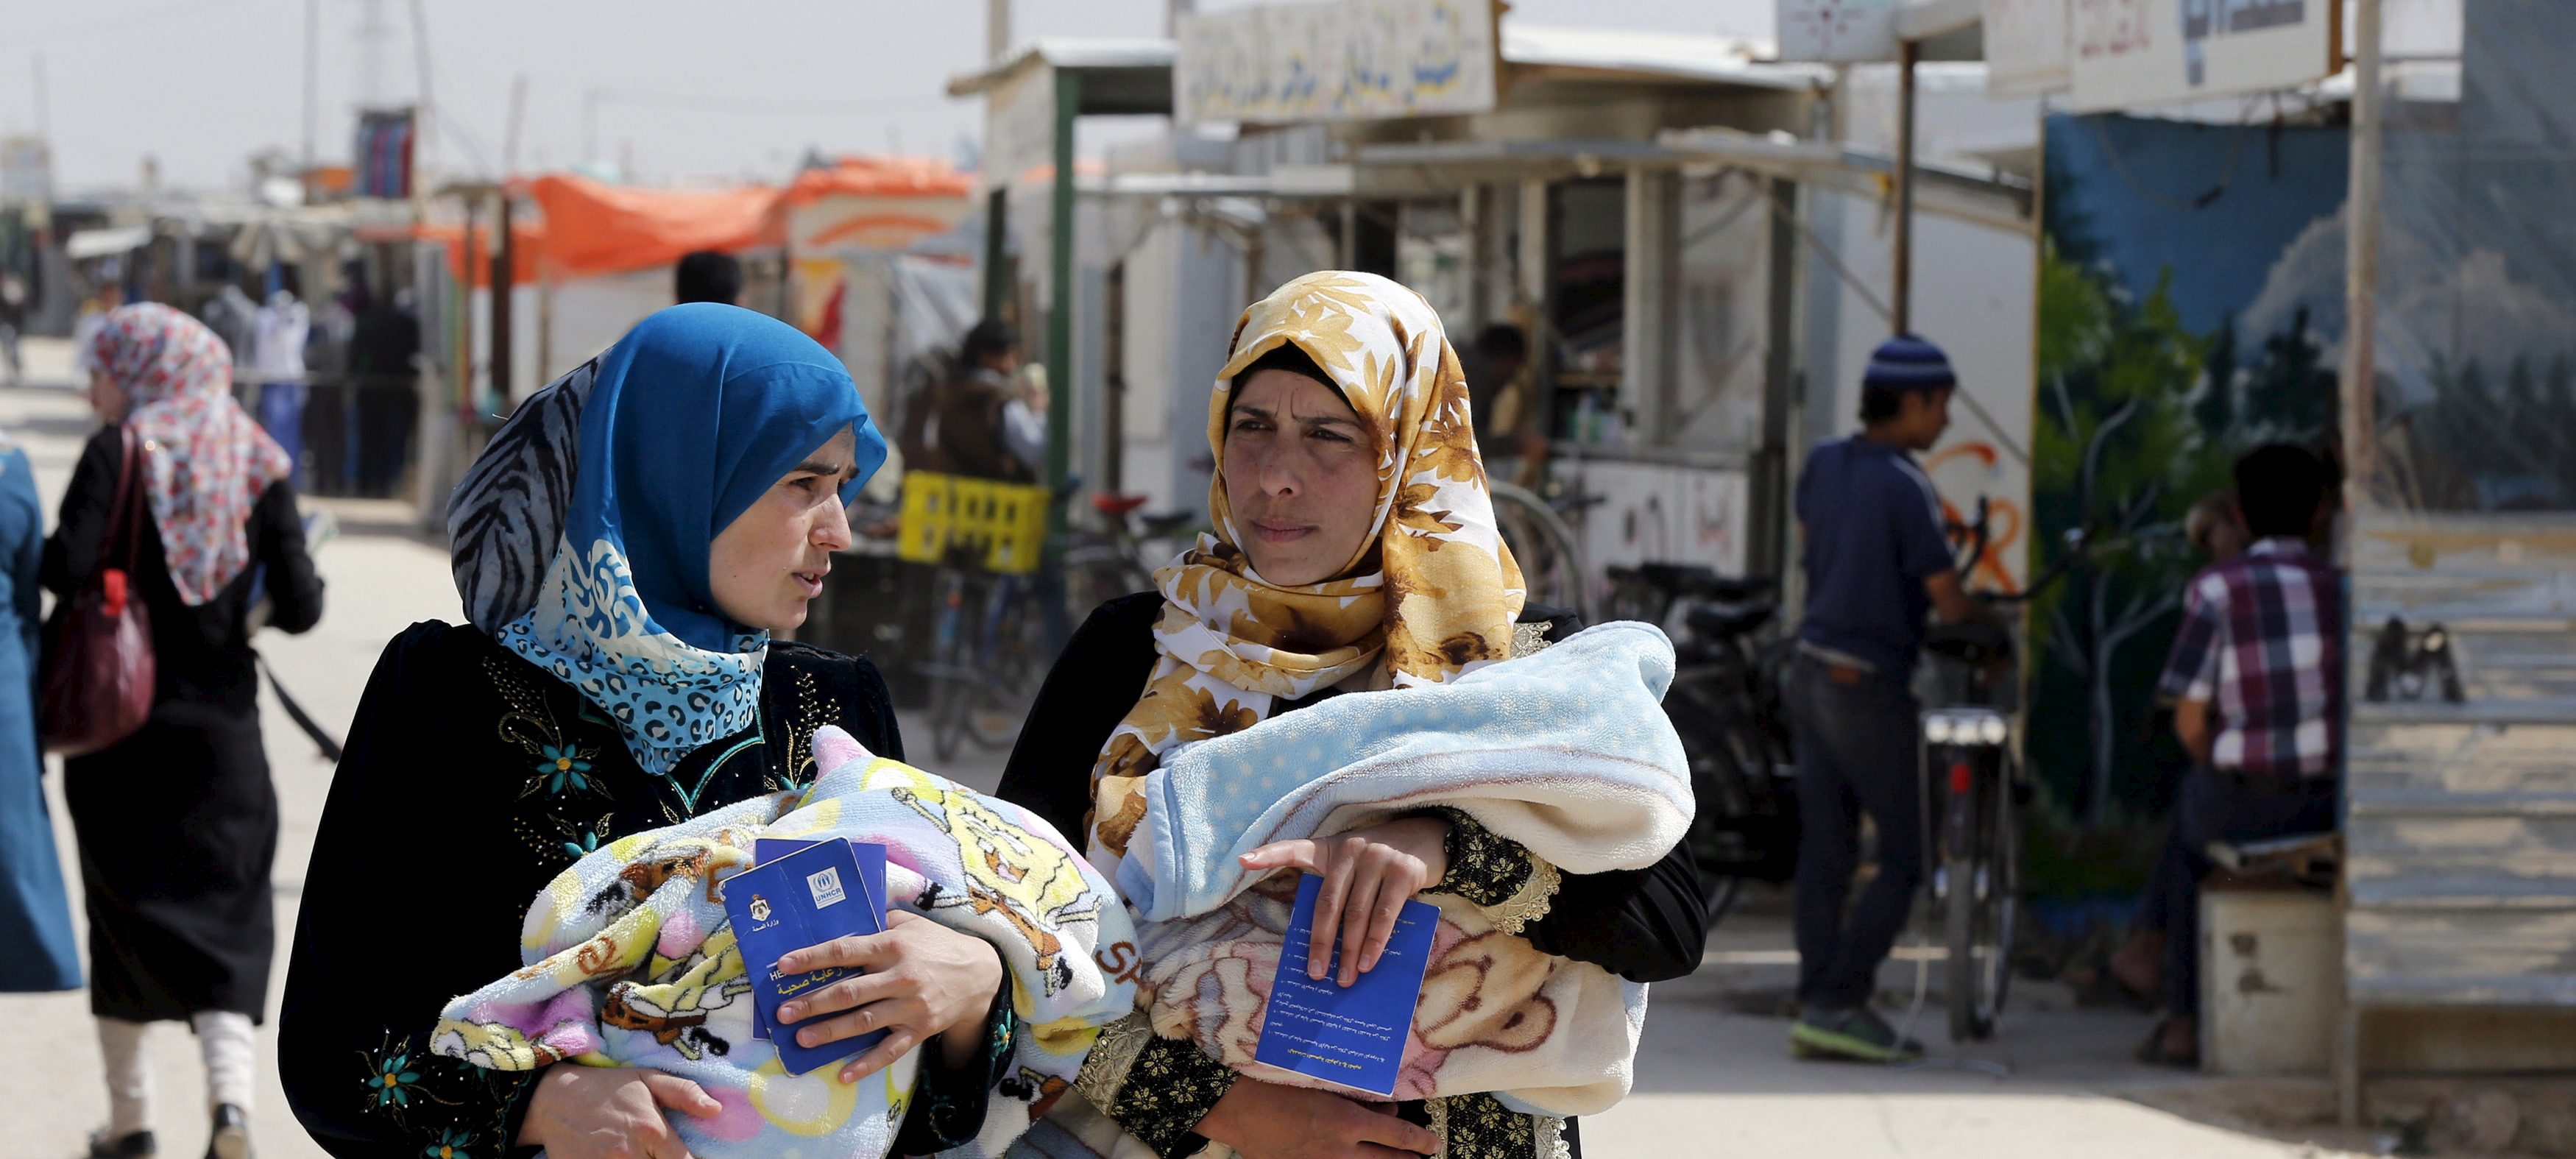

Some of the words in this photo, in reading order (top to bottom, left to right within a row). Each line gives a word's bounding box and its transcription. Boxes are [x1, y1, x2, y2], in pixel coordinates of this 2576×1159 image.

[815, 887, 842, 902] UNHCR
[770, 971, 786, 982] HE
[777, 979, 810, 996] صحية
